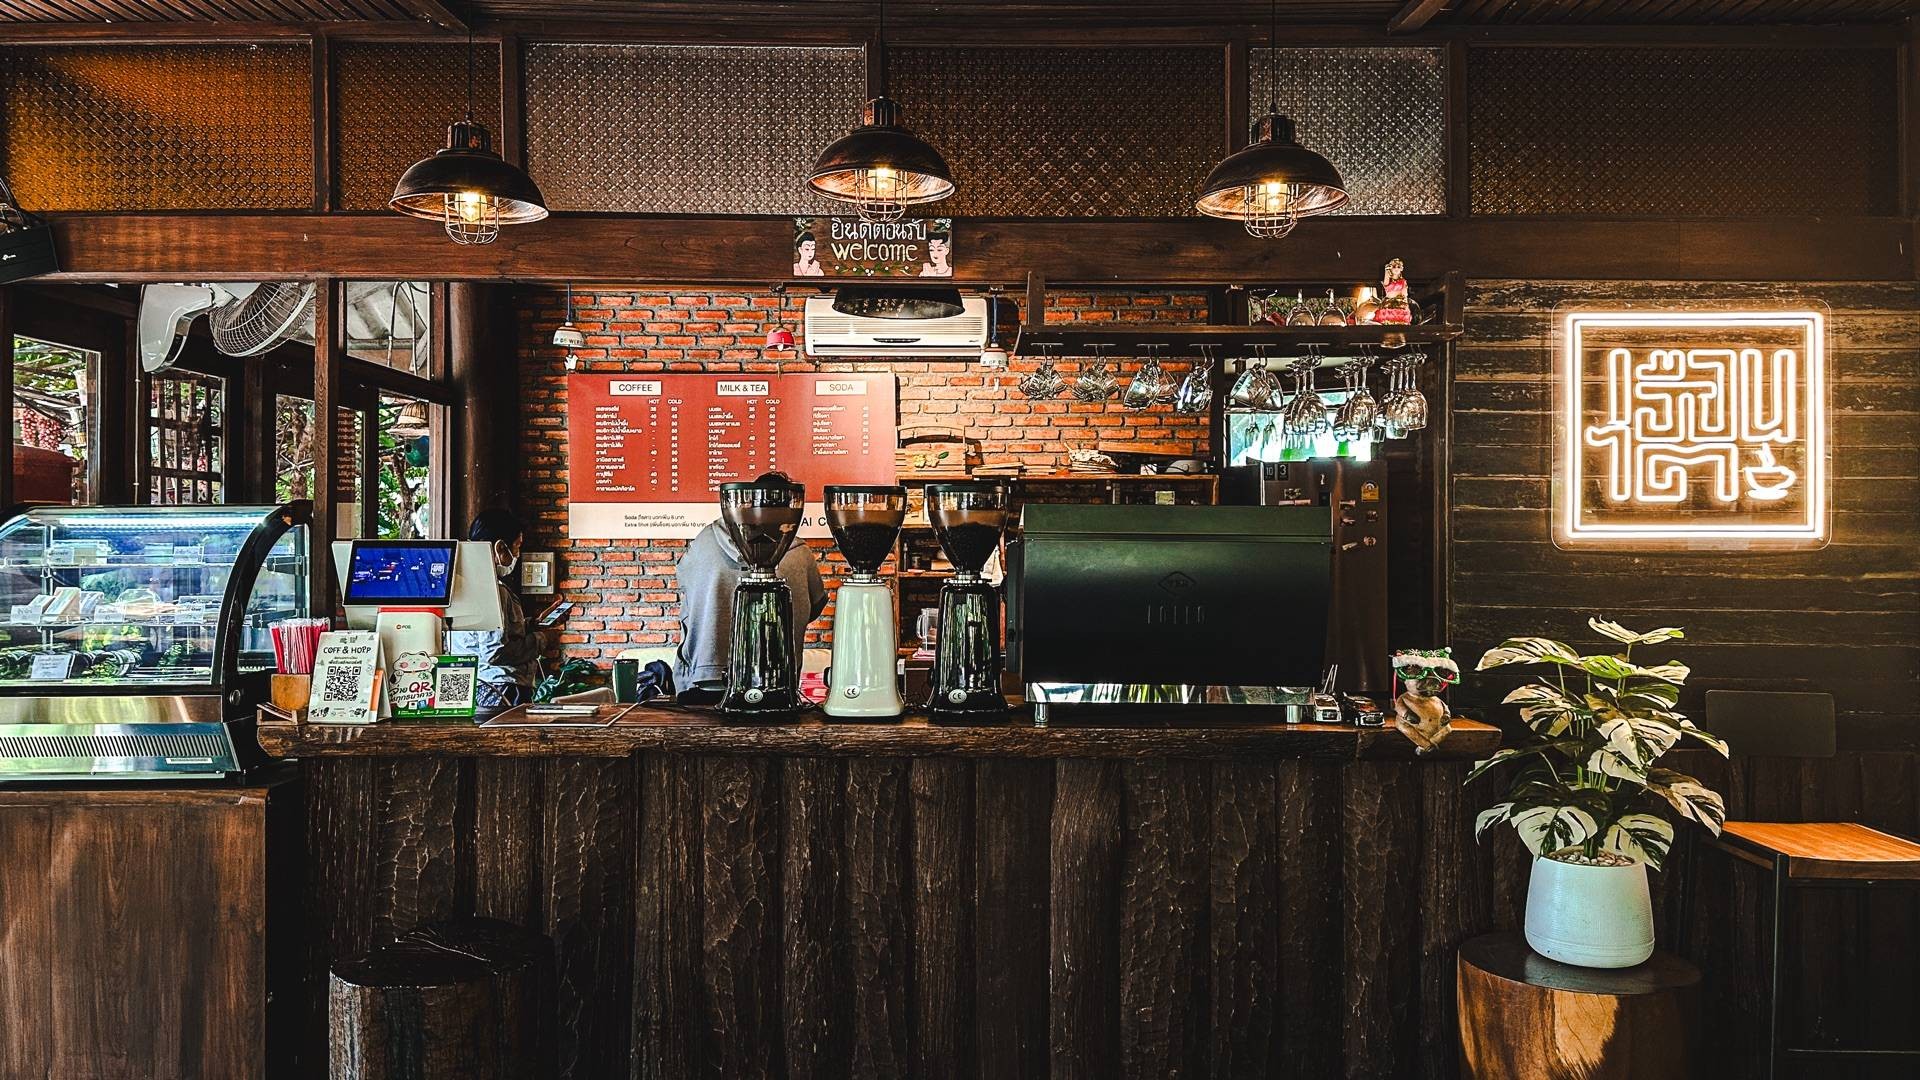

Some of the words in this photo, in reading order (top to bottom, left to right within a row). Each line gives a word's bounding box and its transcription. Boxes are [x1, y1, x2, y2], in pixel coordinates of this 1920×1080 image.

[831, 239, 918, 262] welcome
[618, 383, 653, 392] COFFEE
[720, 384, 742, 392] MILK
[742, 384, 749, 392] &
[750, 384, 767, 392] TEA
[1280, 464, 1287, 476] 3
[801, 517, 812, 526] AI
[409, 682, 431, 693] QR
